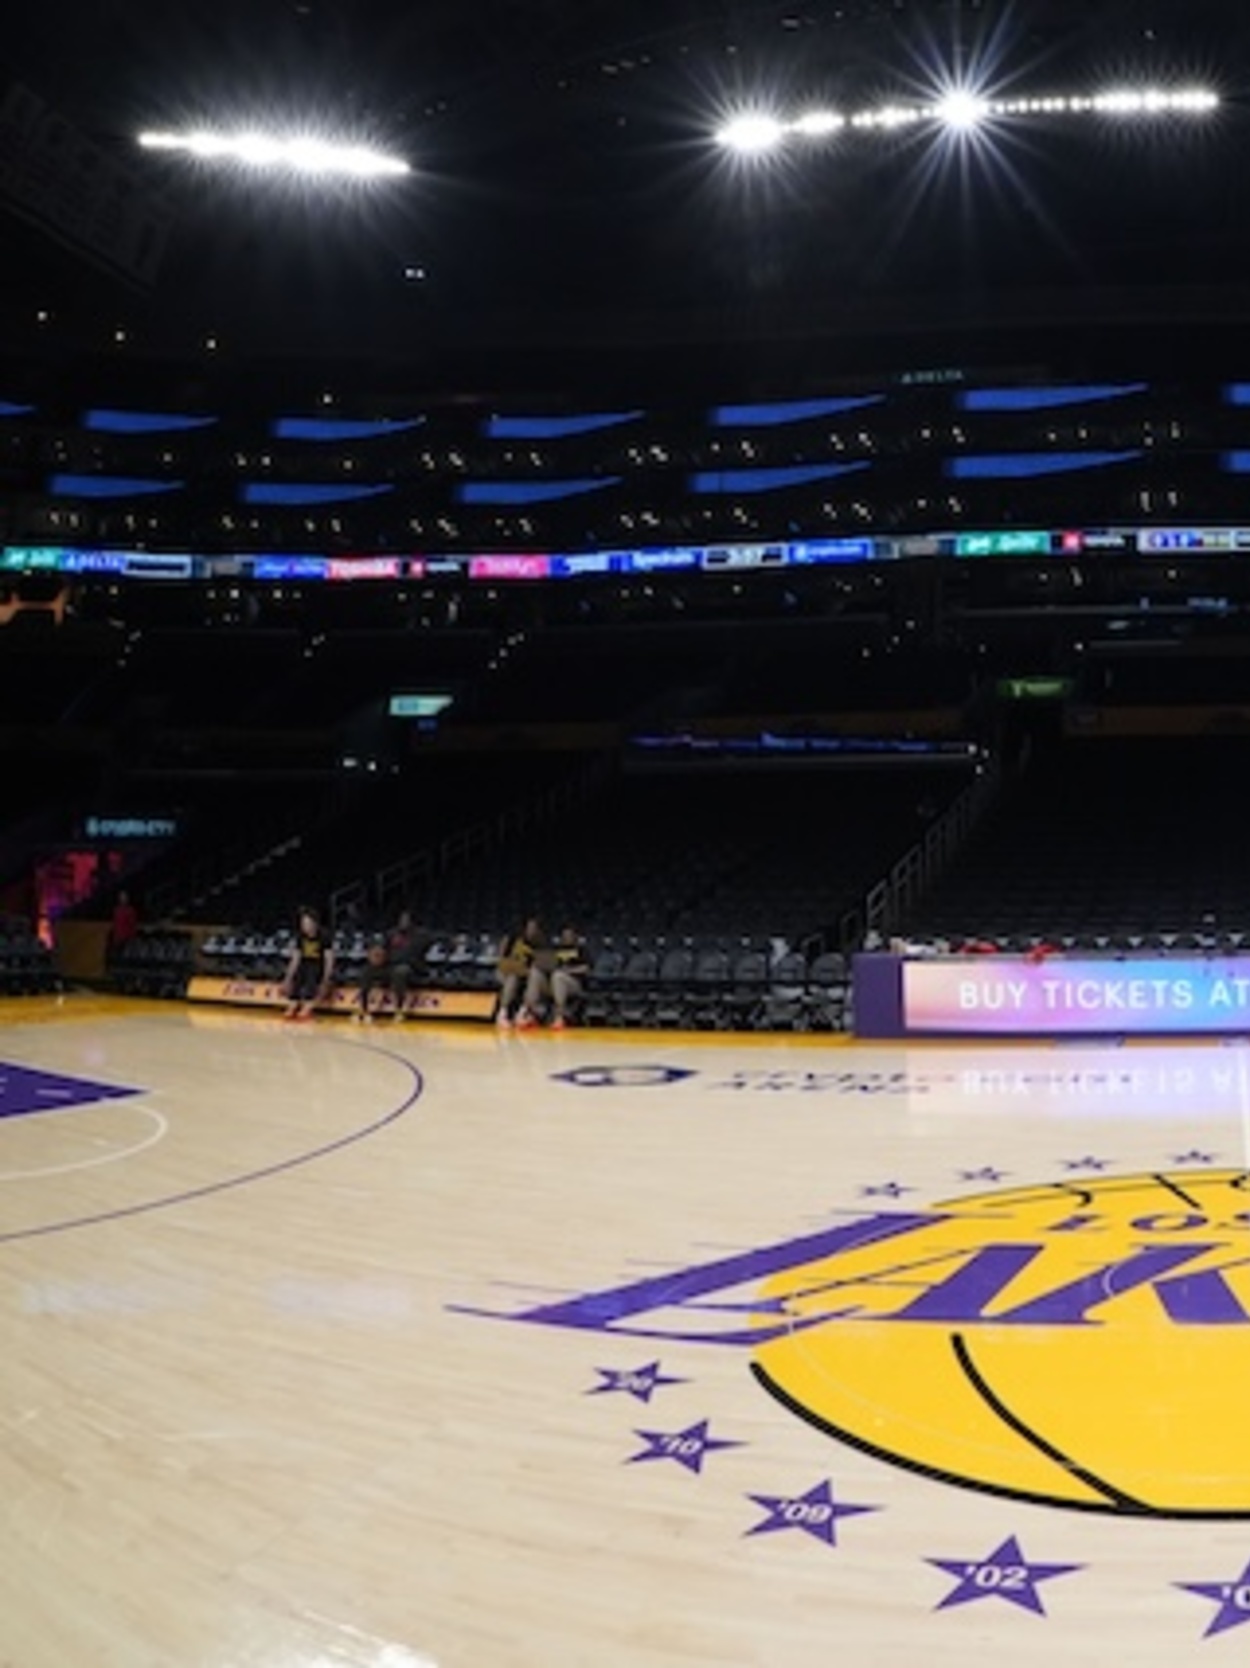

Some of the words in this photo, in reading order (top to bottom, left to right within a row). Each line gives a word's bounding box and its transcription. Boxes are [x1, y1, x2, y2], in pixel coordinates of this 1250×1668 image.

[959, 980, 1026, 1008] BUY
[1042, 978, 1192, 1008] TICKETS
[1209, 978, 1248, 1007] AT
[658, 1434, 702, 1456] '10
[777, 1500, 833, 1525] '09
[963, 1563, 1031, 1592] '02
